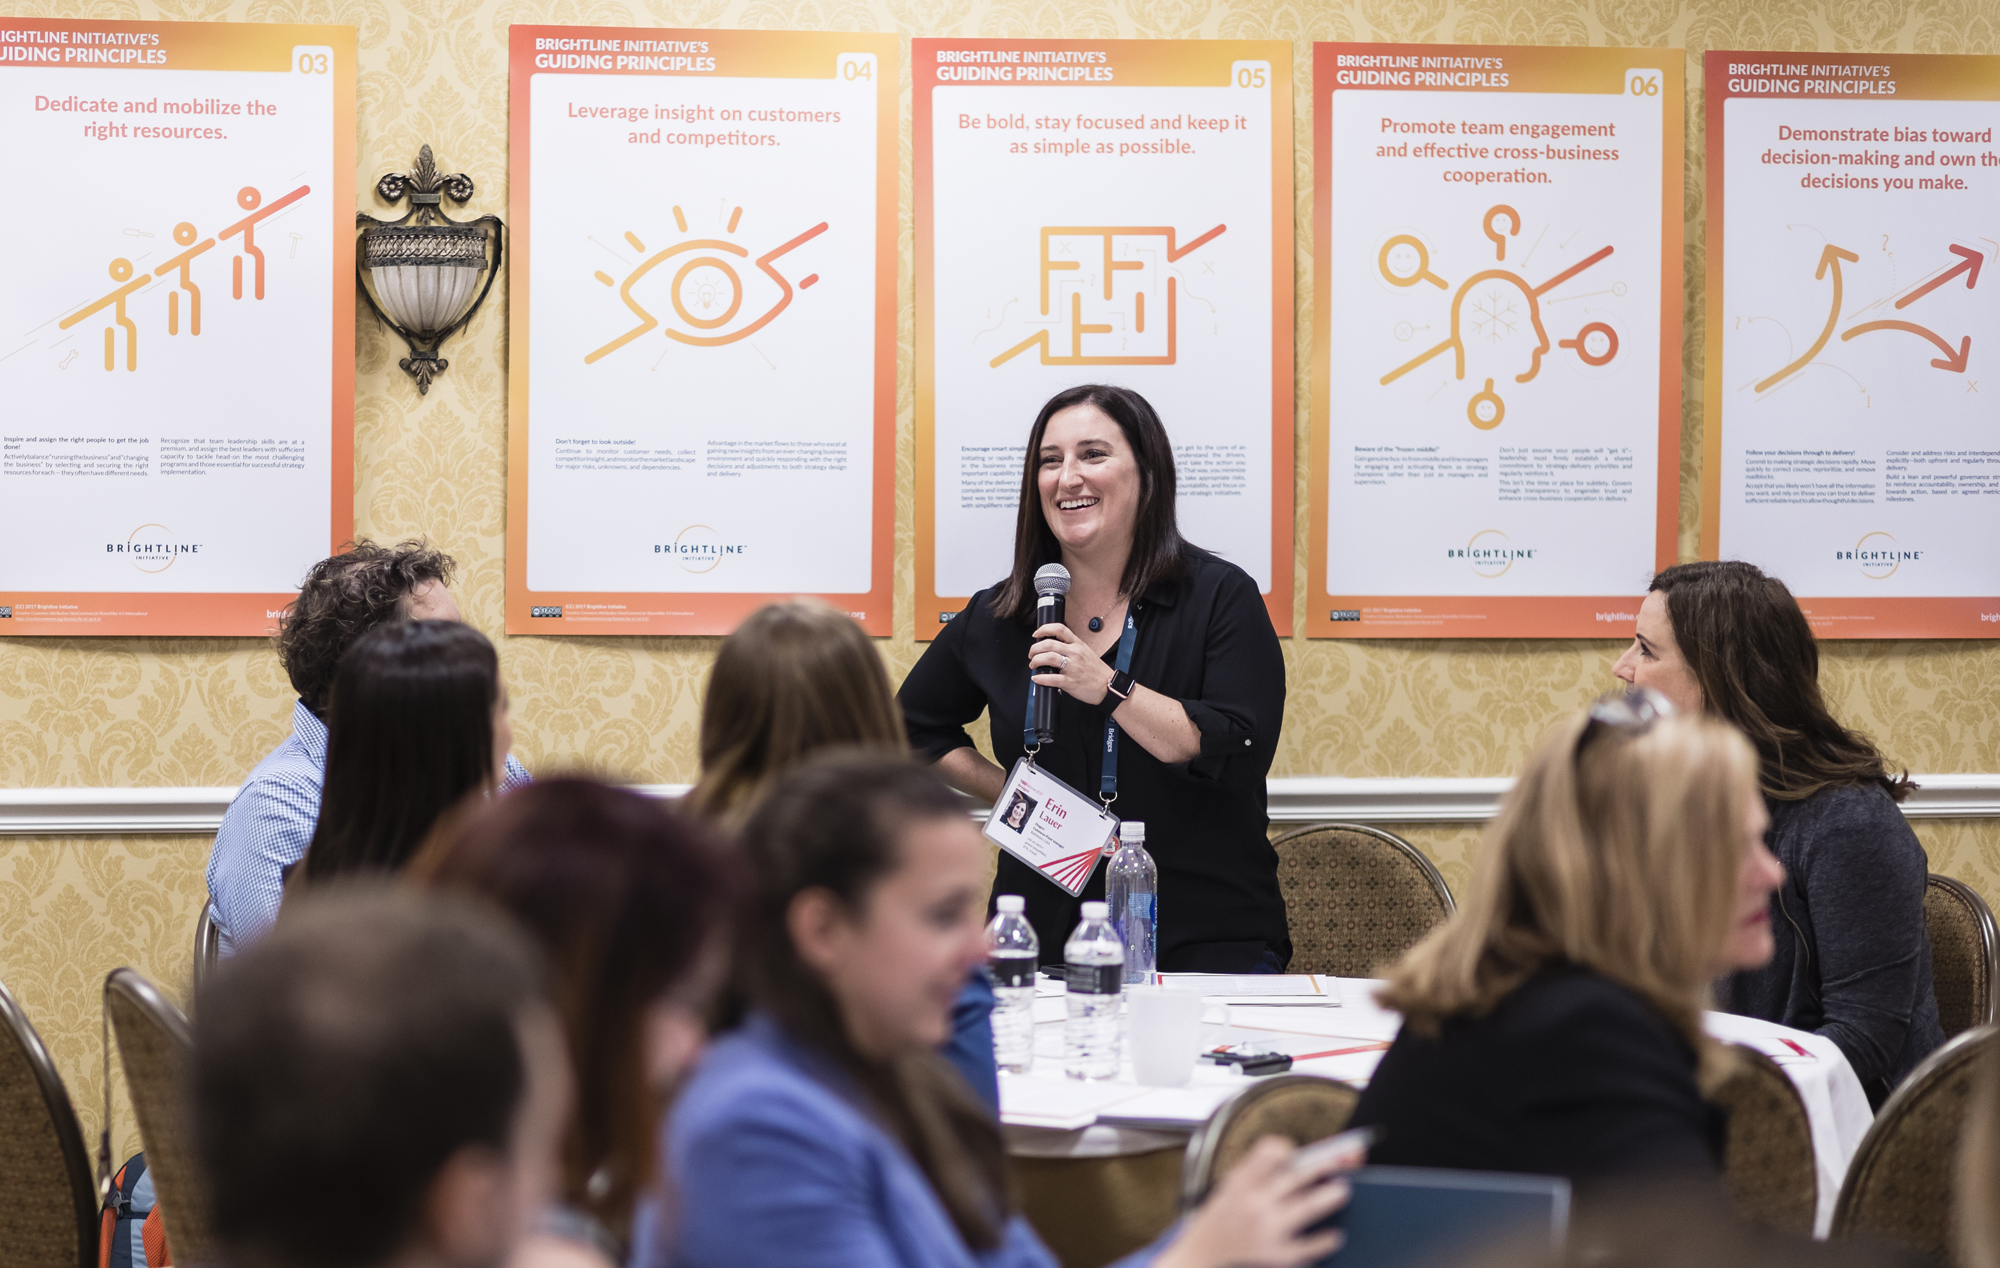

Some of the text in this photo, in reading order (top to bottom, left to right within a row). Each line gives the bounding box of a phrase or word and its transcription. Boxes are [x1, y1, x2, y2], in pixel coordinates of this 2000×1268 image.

[0, 30, 68, 43] IGHTLINE
[536, 38, 621, 51] BRIGHTLINE
[0, 46, 166, 64] UIDING PRINCIPLES
[299, 53, 328, 74] 03
[535, 54, 716, 71] GUIDING PRINCIPLES
[937, 51, 1020, 63] BRIGHTLINE
[1337, 55, 1419, 68] BRIGHTLINE
[844, 61, 872, 81] 04
[936, 66, 1113, 81] GUIDING PRINCIPLES
[1238, 68, 1265, 88] 05
[1337, 70, 1509, 87] GUIDING PRINCIPLES
[1729, 64, 1808, 75] BRIGHTLINE
[1631, 76, 1658, 96] 06
[1728, 79, 1896, 94] GUIDING PRINCIPLES
[35, 96, 276, 115] Dedicate and mobilize the
[569, 102, 840, 123] Leverage insight on customers
[85, 121, 227, 140] right resources.
[960, 114, 1246, 132] Be bold, stay focused and keep it
[1382, 118, 1615, 139] Promote team engagement
[628, 128, 780, 148] and competitors.
[1779, 126, 1991, 143] Demonstrate bias toward
[1010, 138, 1195, 156] as simple as possible.
[1377, 142, 1619, 160] and effective cross-business
[1762, 149, 2000, 169] decision-making and own th
[1443, 168, 1552, 185] cooperation.
[1801, 173, 1968, 192] decisions you make.
[107, 542, 197, 555] BRIGHTLINE
[655, 542, 742, 556] BRIGHTLINE
[1448, 547, 1532, 560] BRIGHTLINE
[1837, 549, 1919, 562] BRIGHTLINE
[1596, 612, 1639, 623] brightline.
[1045, 798, 1067, 820] Erin
[1039, 811, 1063, 830] Lauer
